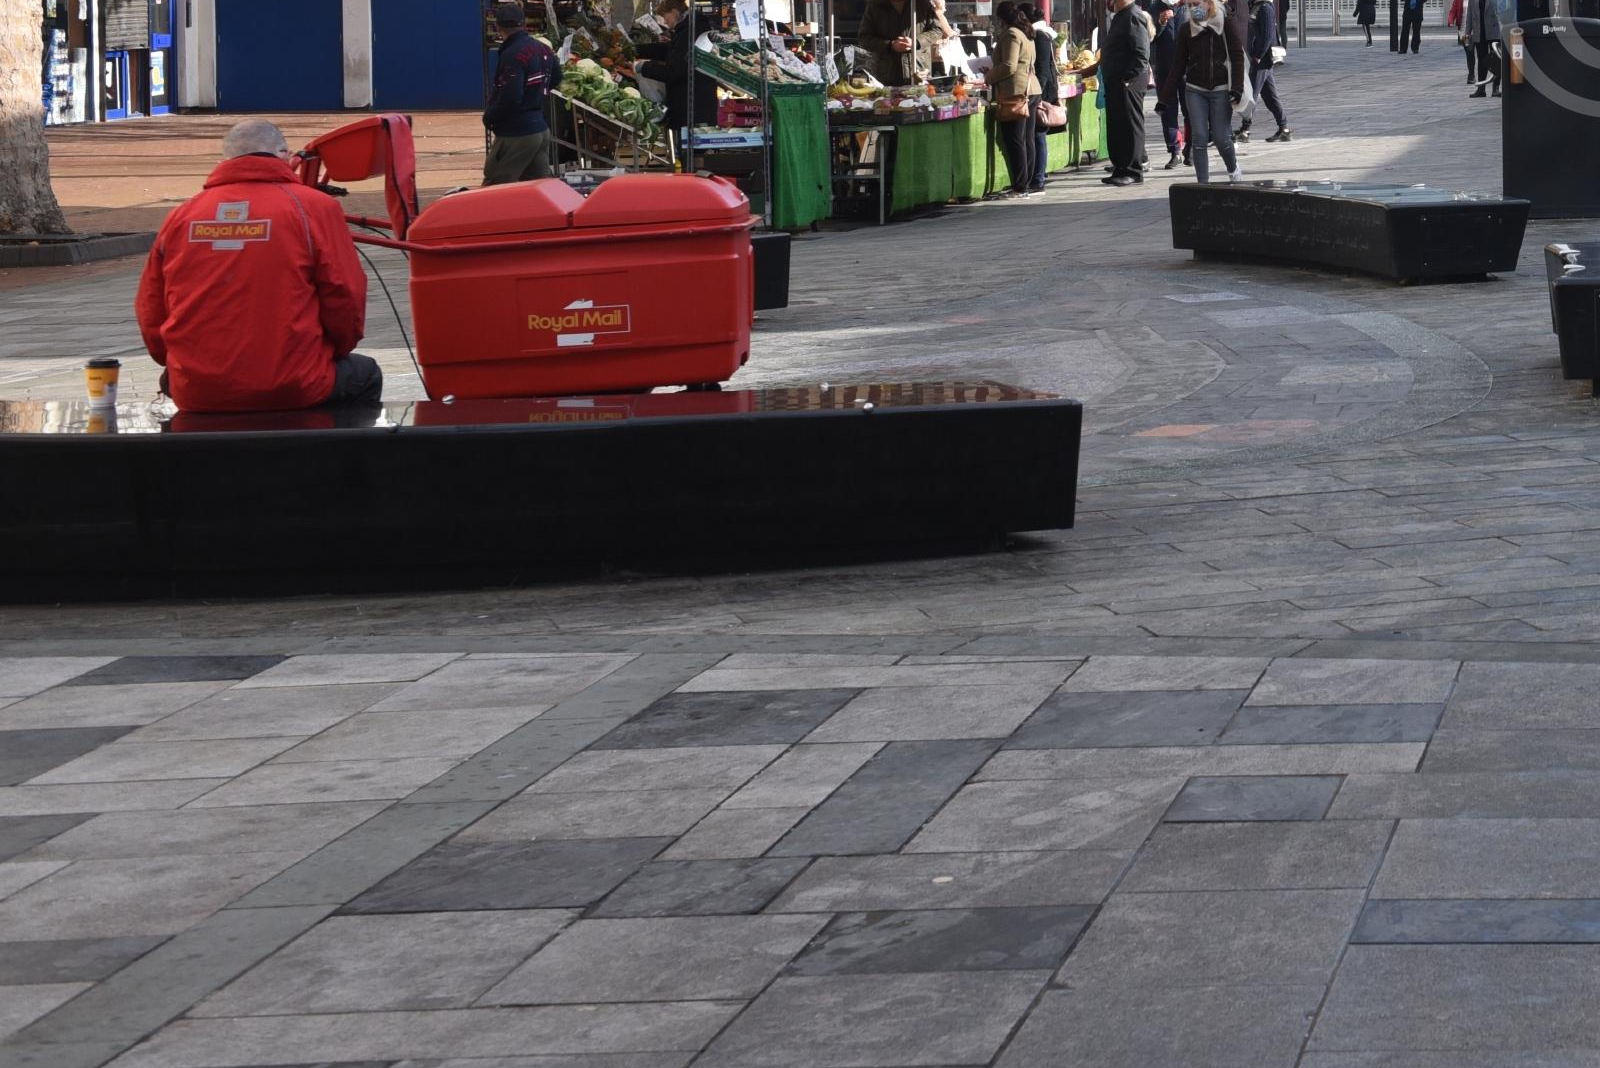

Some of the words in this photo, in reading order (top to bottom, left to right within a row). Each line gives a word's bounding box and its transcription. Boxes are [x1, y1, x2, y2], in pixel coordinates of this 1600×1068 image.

[745, 118, 763, 126] MOY
[194, 224, 232, 238] Royal
[234, 223, 265, 235] Mail
[527, 312, 579, 332] Royal
[583, 310, 622, 327] Mail
